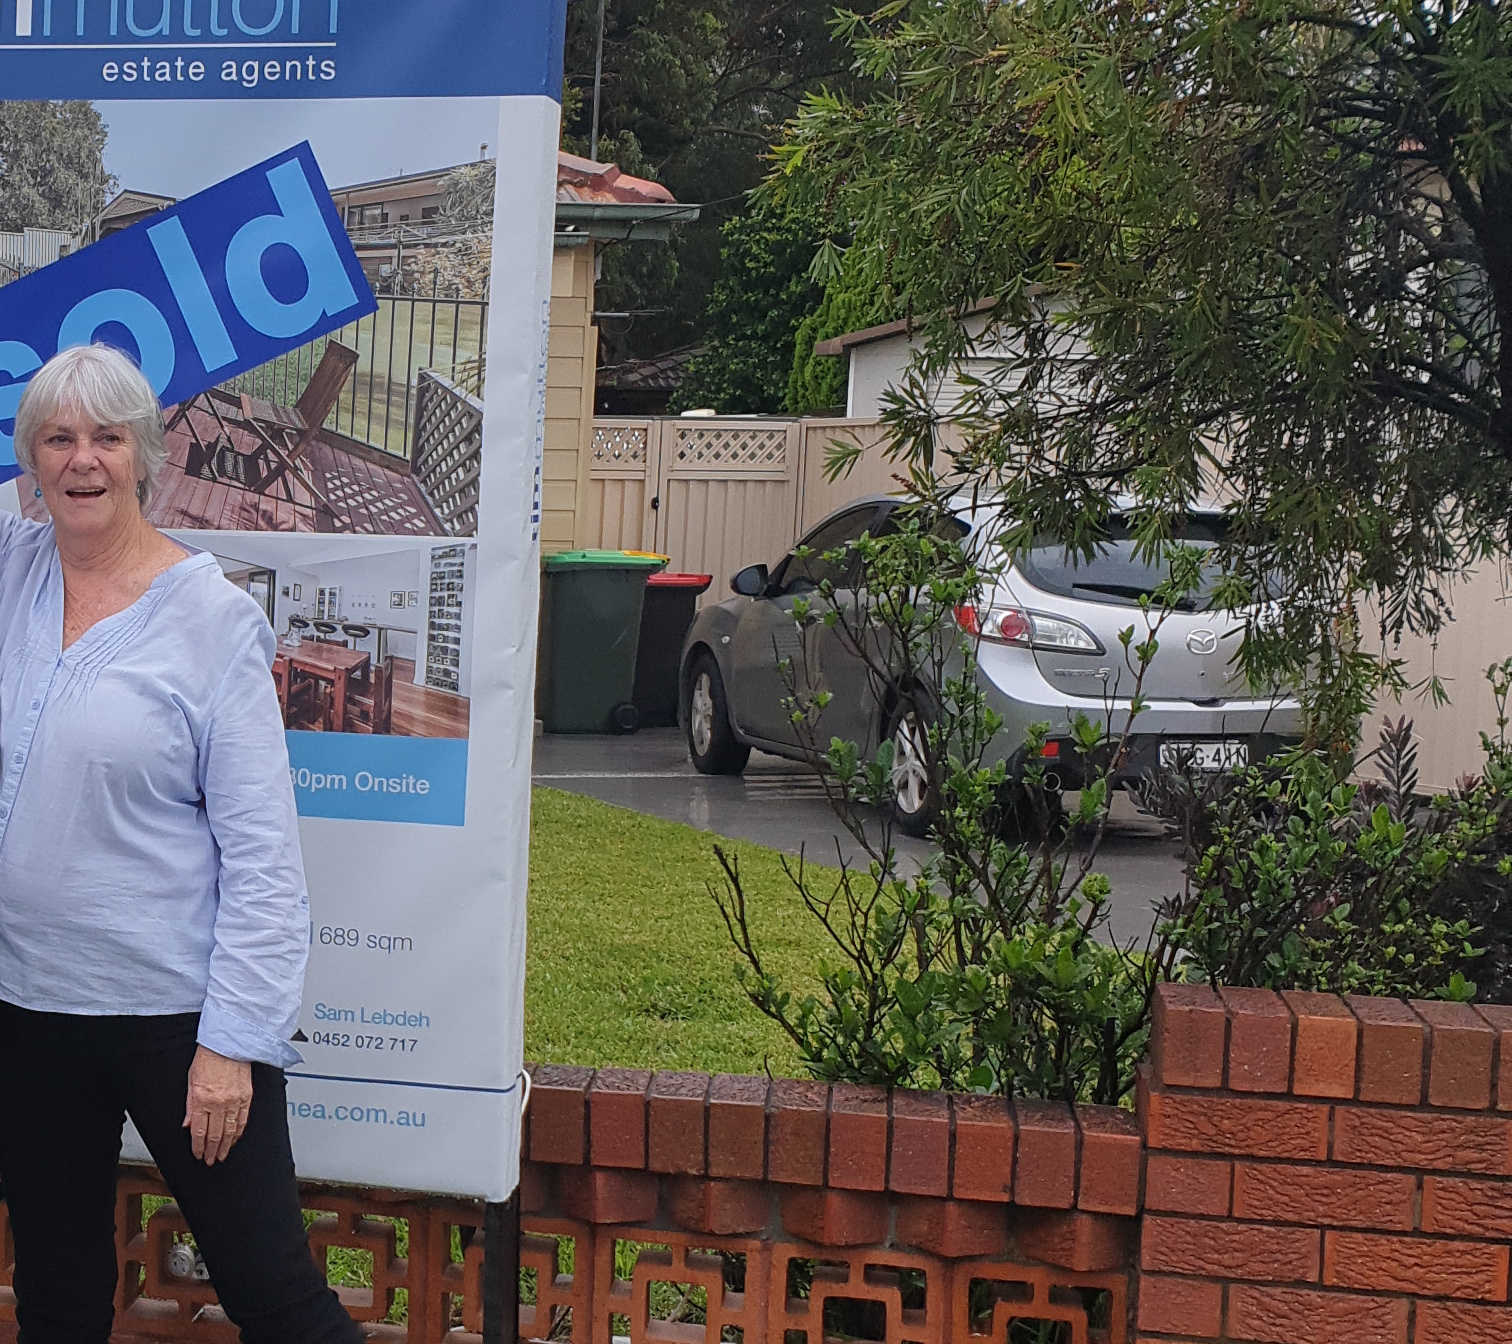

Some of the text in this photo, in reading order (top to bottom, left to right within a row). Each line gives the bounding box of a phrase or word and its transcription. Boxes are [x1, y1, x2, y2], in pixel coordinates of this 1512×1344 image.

[101, 56, 337, 88] estate agents
[354, 771, 431, 795] Onsite
[319, 926, 413, 955] 689 sqm
[314, 1003, 430, 1028] Sam Lebdeh
[312, 1031, 418, 1052] 0452 072 717
